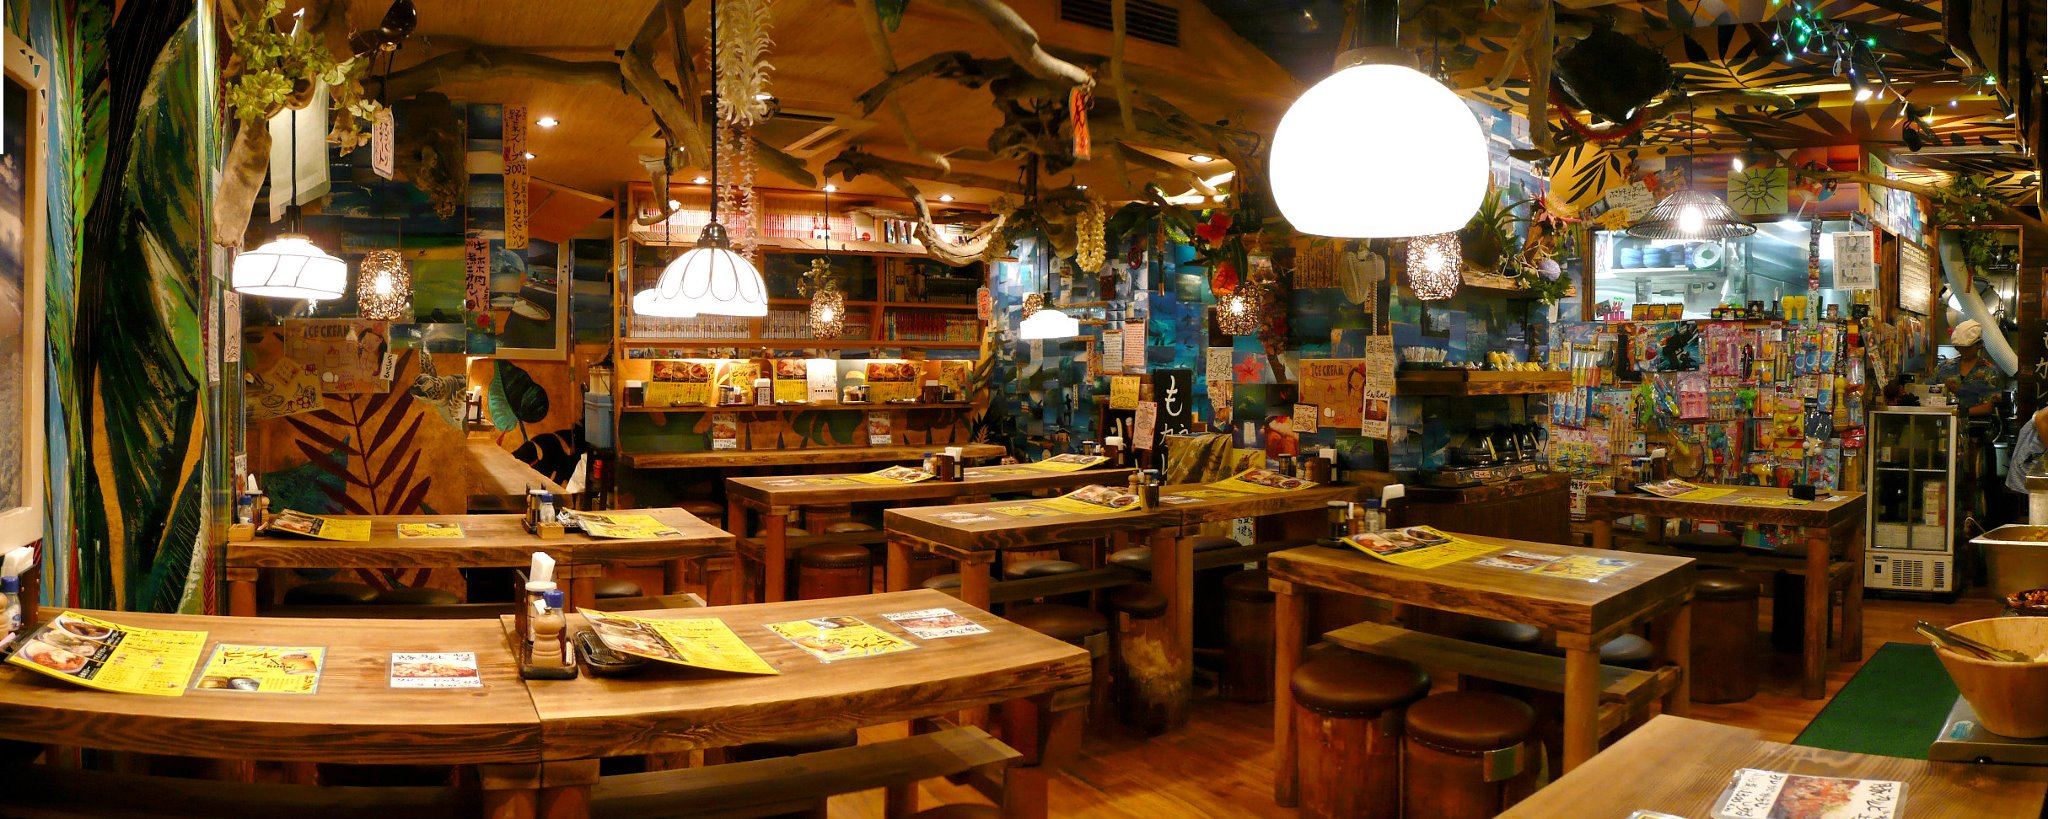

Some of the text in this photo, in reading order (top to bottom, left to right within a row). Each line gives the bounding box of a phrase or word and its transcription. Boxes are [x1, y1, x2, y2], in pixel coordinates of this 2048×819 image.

[511, 179, 525, 249] もうやんスペシャル
[303, 323, 350, 338] ICE CREAM
[1311, 362, 1345, 377] ICE CREAM
